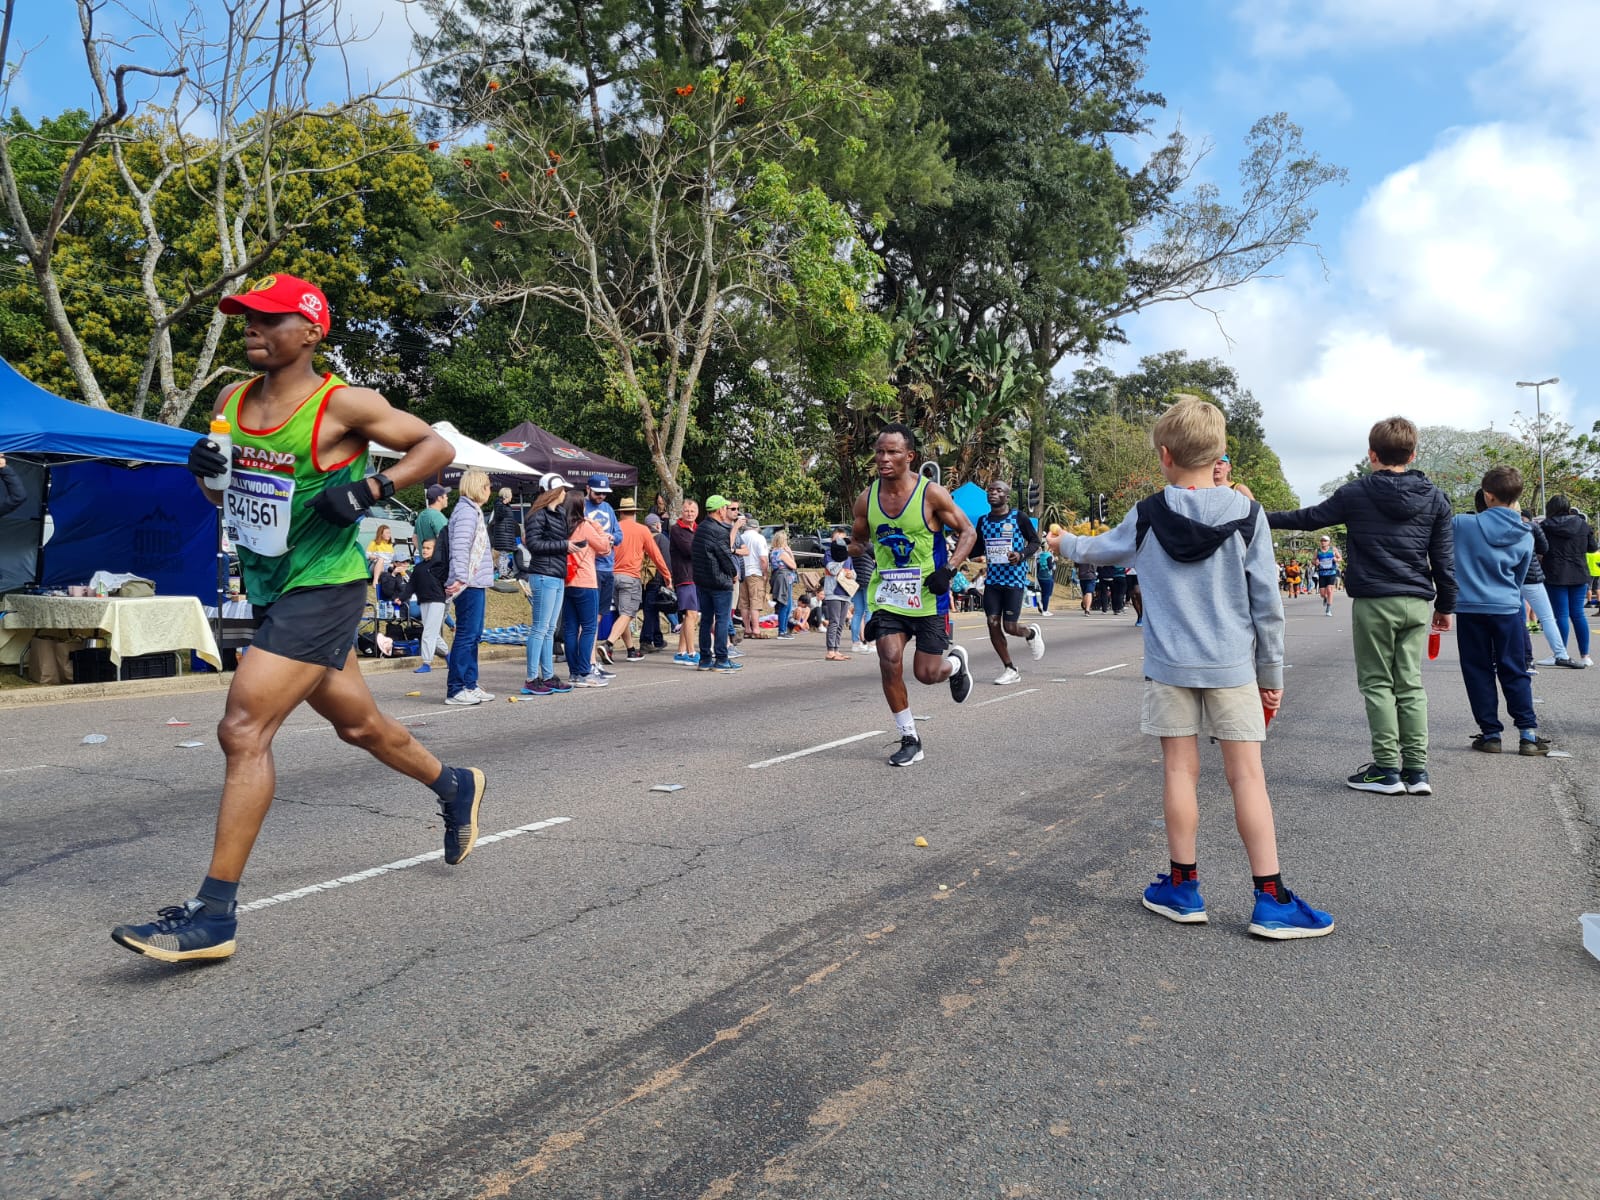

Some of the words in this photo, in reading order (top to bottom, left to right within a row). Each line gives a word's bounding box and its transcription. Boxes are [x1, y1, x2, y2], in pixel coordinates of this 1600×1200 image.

[298, 302, 319, 320] TOYOTA
[227, 493, 278, 528] B41561
[907, 595, 920, 608] 40
